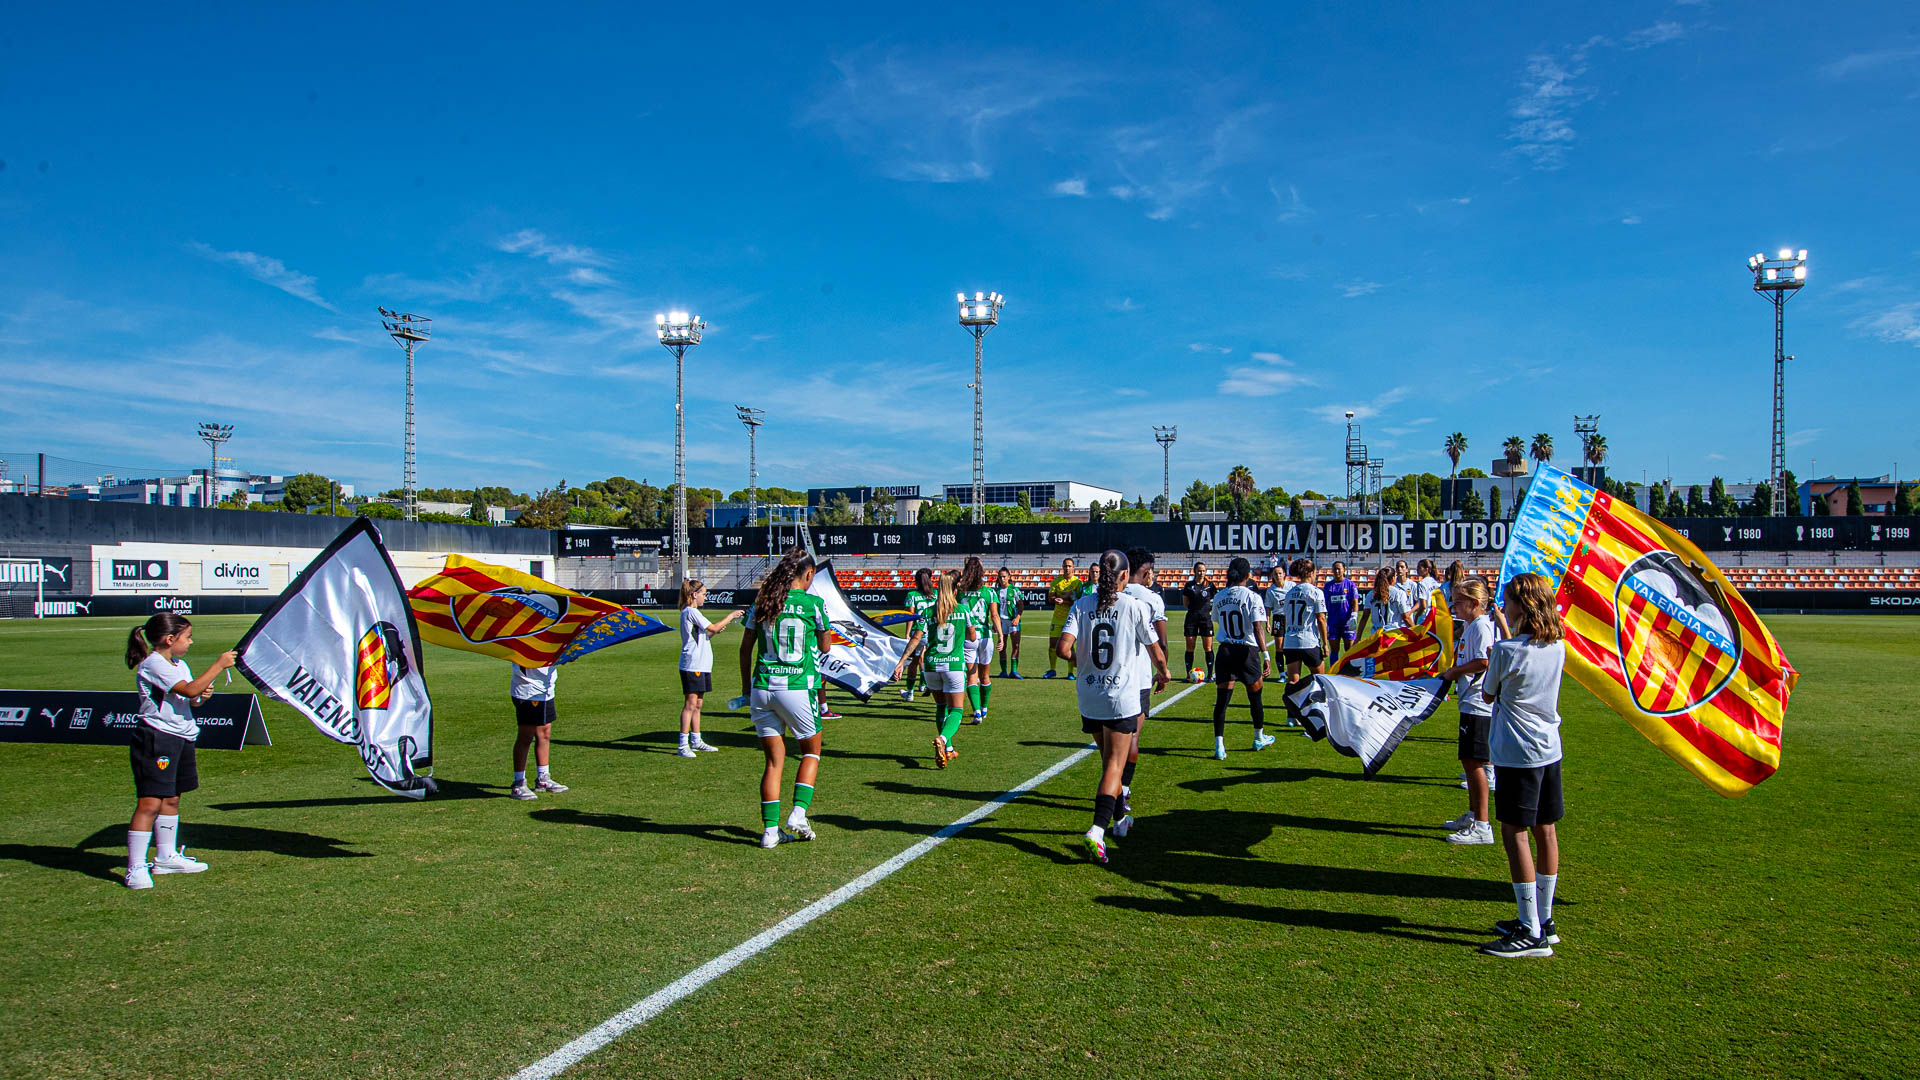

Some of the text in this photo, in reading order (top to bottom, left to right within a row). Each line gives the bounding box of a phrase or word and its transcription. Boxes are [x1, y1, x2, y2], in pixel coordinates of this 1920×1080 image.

[994, 533, 1013, 543] 1967
[1054, 533, 1072, 543] 1971
[1185, 524, 1300, 550] VALENCIA
[1309, 523, 1373, 549] CLUB
[1383, 523, 1414, 549] DE
[1738, 529, 1762, 539] 1980
[1810, 528, 1834, 538] 1980
[1885, 527, 1910, 538] 1999
[575, 538, 590, 547] 1941
[726, 536, 743, 545] 1947
[830, 535, 847, 544] 1954
[883, 535, 901, 544] 1962
[937, 535, 956, 544] 1963
[0, 563, 45, 582] UMA
[115, 564, 136, 576] TM
[214, 562, 260, 578] divina
[1022, 591, 1046, 601] ivina
[154, 596, 193, 609] divina
[1088, 609, 1119, 621] GEMA
[1288, 600, 1307, 626] 17
[1632, 579, 1732, 655] VALENCIA C.F.
[1219, 610, 1246, 640] 10
[762, 617, 806, 664] 10
[936, 623, 955, 654] 9
[1091, 622, 1115, 671] 6
[768, 666, 804, 675] trainline
[828, 658, 851, 675] CF
[114, 713, 140, 724] MSC
